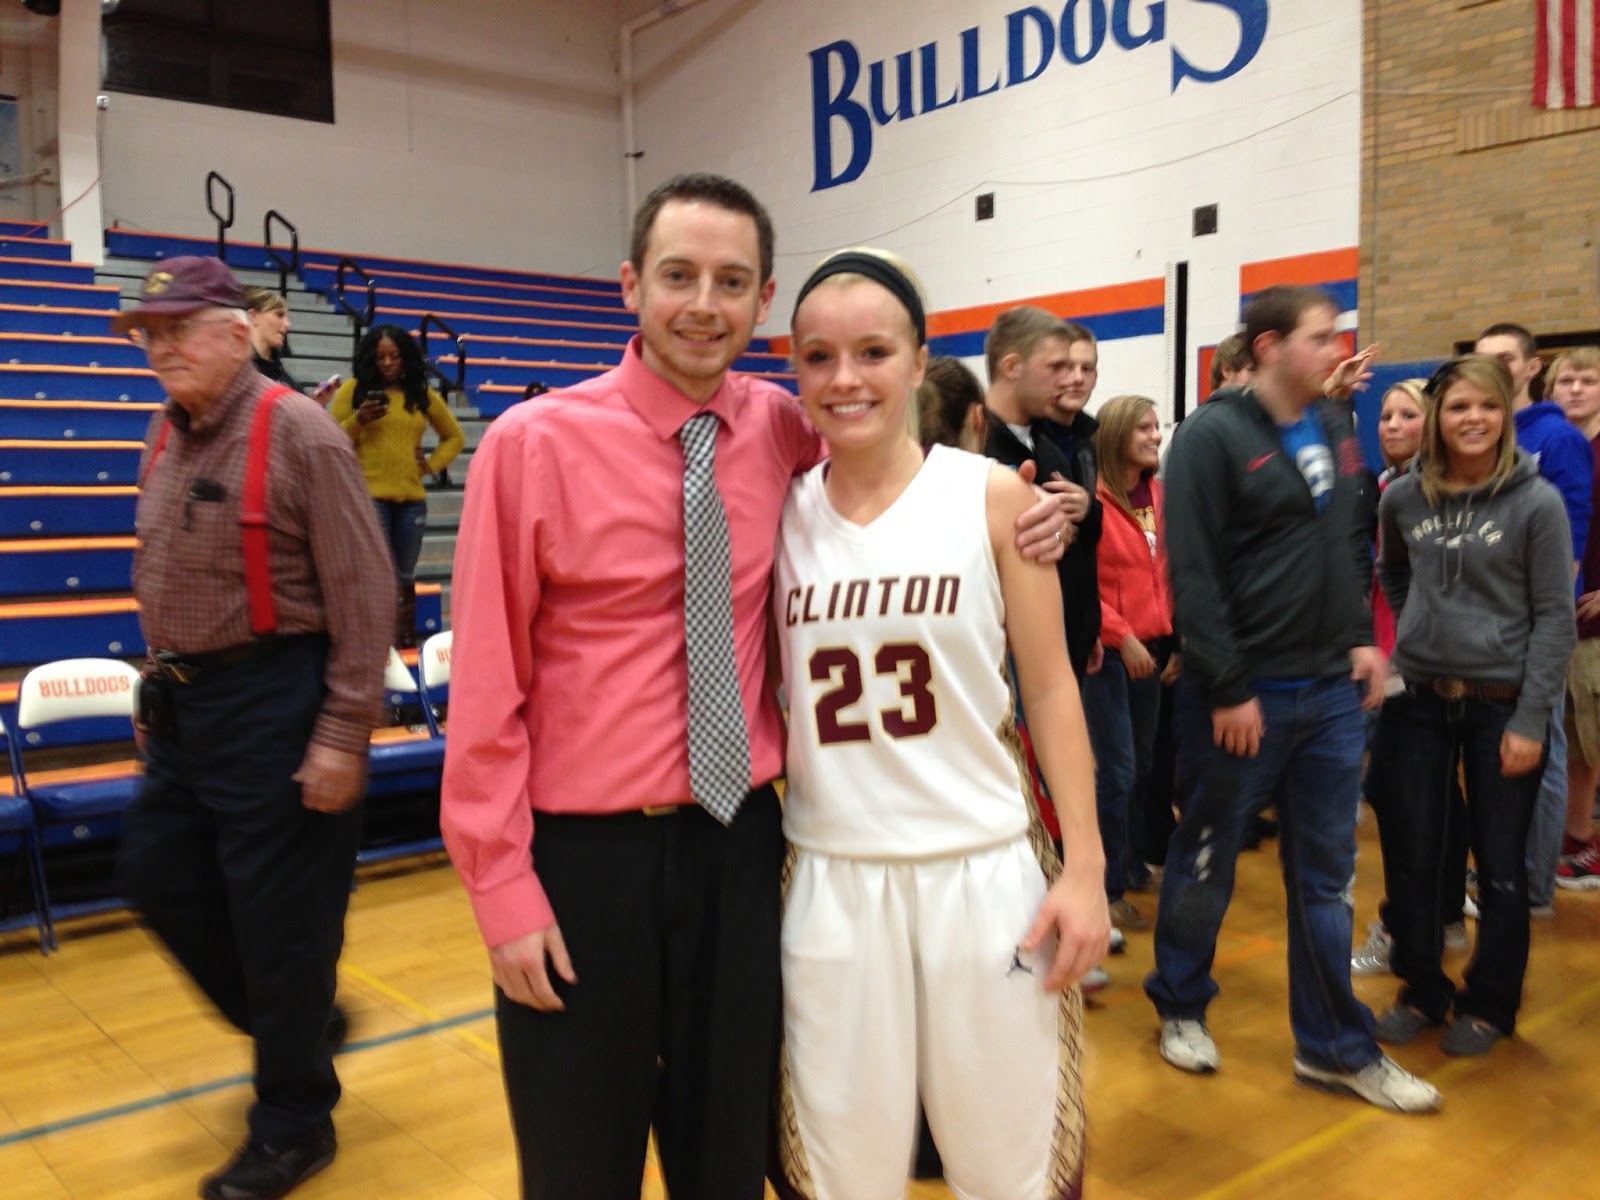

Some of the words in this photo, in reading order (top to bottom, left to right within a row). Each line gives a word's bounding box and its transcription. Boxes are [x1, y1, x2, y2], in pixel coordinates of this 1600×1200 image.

[808, 0, 1270, 193] BULLDOGS
[786, 575, 961, 627] CLINTON
[39, 675, 130, 698] BULLDOGS
[808, 641, 938, 747] 23
